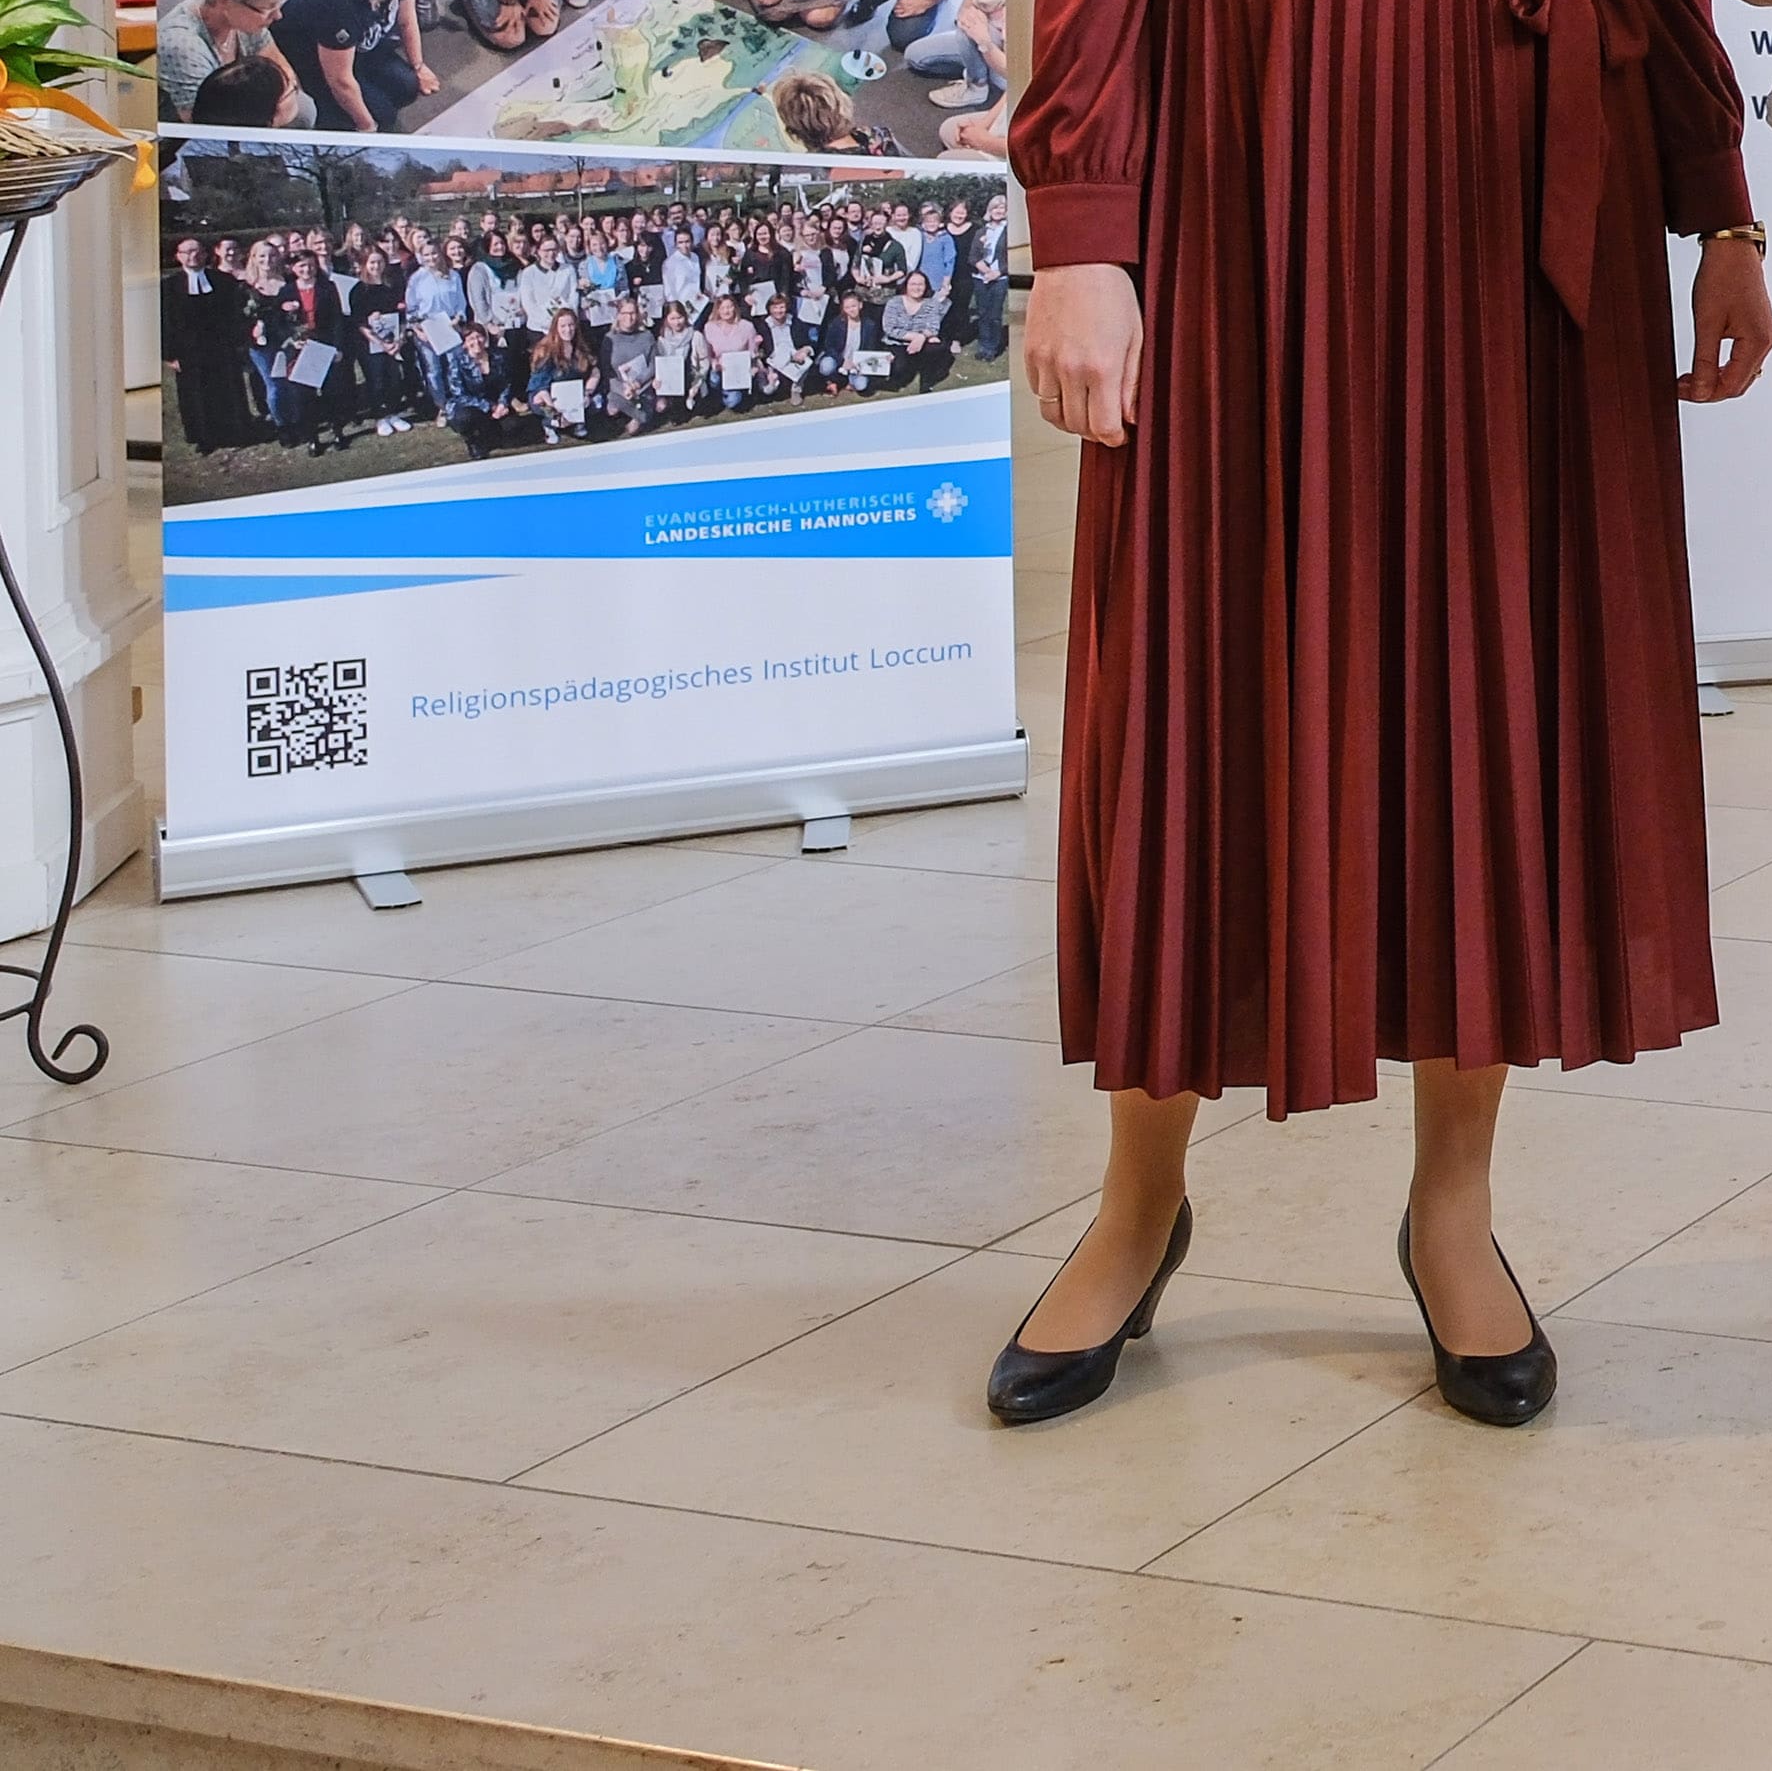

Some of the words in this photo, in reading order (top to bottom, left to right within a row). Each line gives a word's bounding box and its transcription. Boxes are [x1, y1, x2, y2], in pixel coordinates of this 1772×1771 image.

[644, 490, 916, 528] EVANGELISCH-LUTHERISCHE
[644, 518, 793, 545] LANDESKIRCHE
[800, 508, 917, 531] HANNOVERS
[411, 664, 753, 720] Religionspädagogisches
[763, 653, 859, 680] Institut
[870, 641, 972, 669] Loccum
